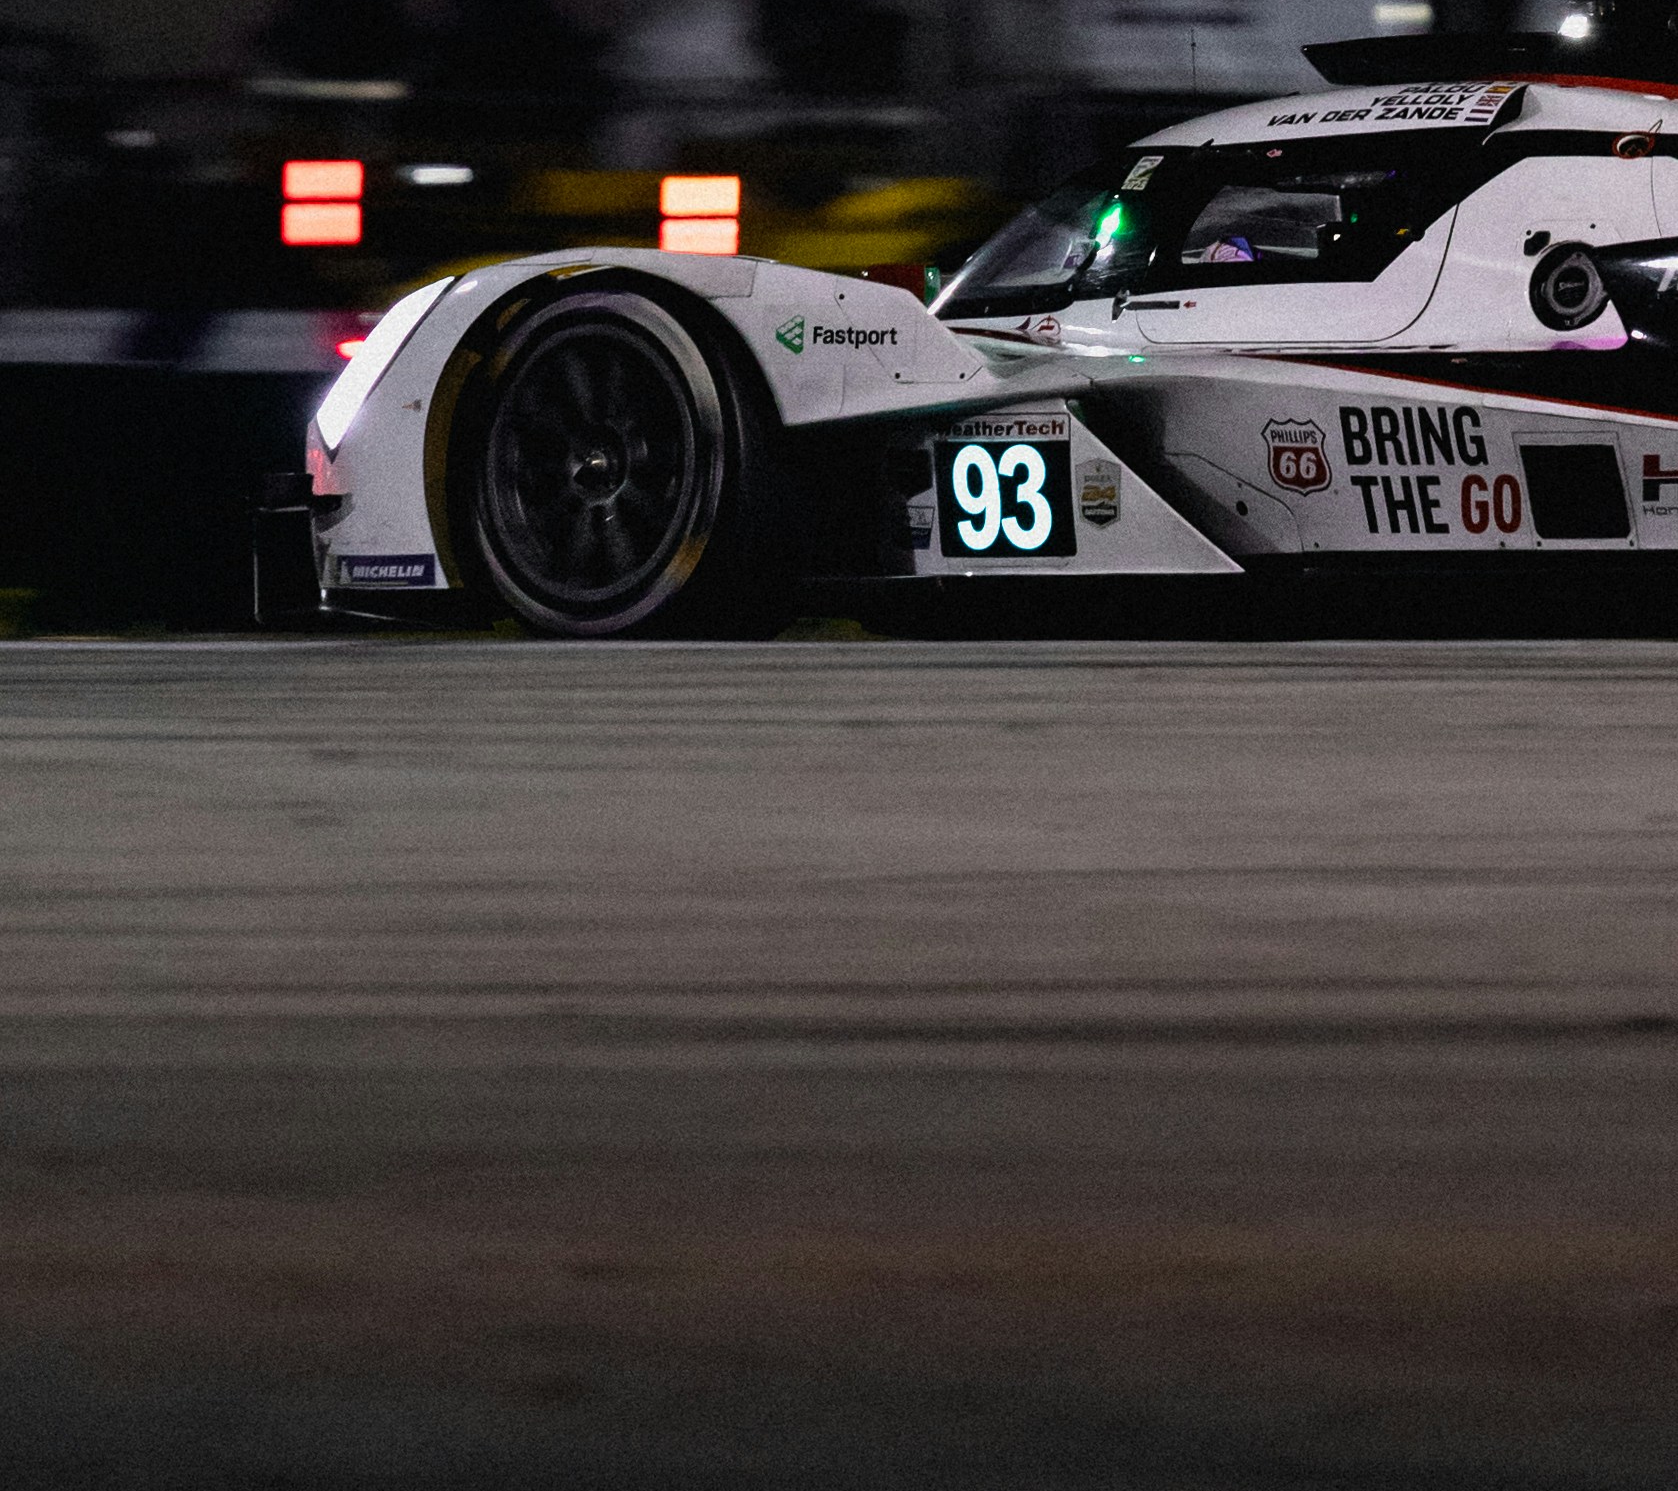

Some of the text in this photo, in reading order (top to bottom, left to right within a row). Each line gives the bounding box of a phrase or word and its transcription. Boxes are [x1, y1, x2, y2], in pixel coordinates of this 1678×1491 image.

[1370, 94, 1474, 107] YELLOLY
[1266, 107, 1465, 127] VAN DER ZANDE
[812, 326, 898, 349] Fastport
[944, 420, 1065, 436] eatherTech
[1270, 429, 1318, 444] PHILLIPS
[1339, 406, 1489, 466] BRING
[1279, 451, 1320, 479] 66
[952, 444, 1053, 550] 93
[1350, 473, 1522, 534] THE GO
[352, 564, 425, 579] MICHELIN
